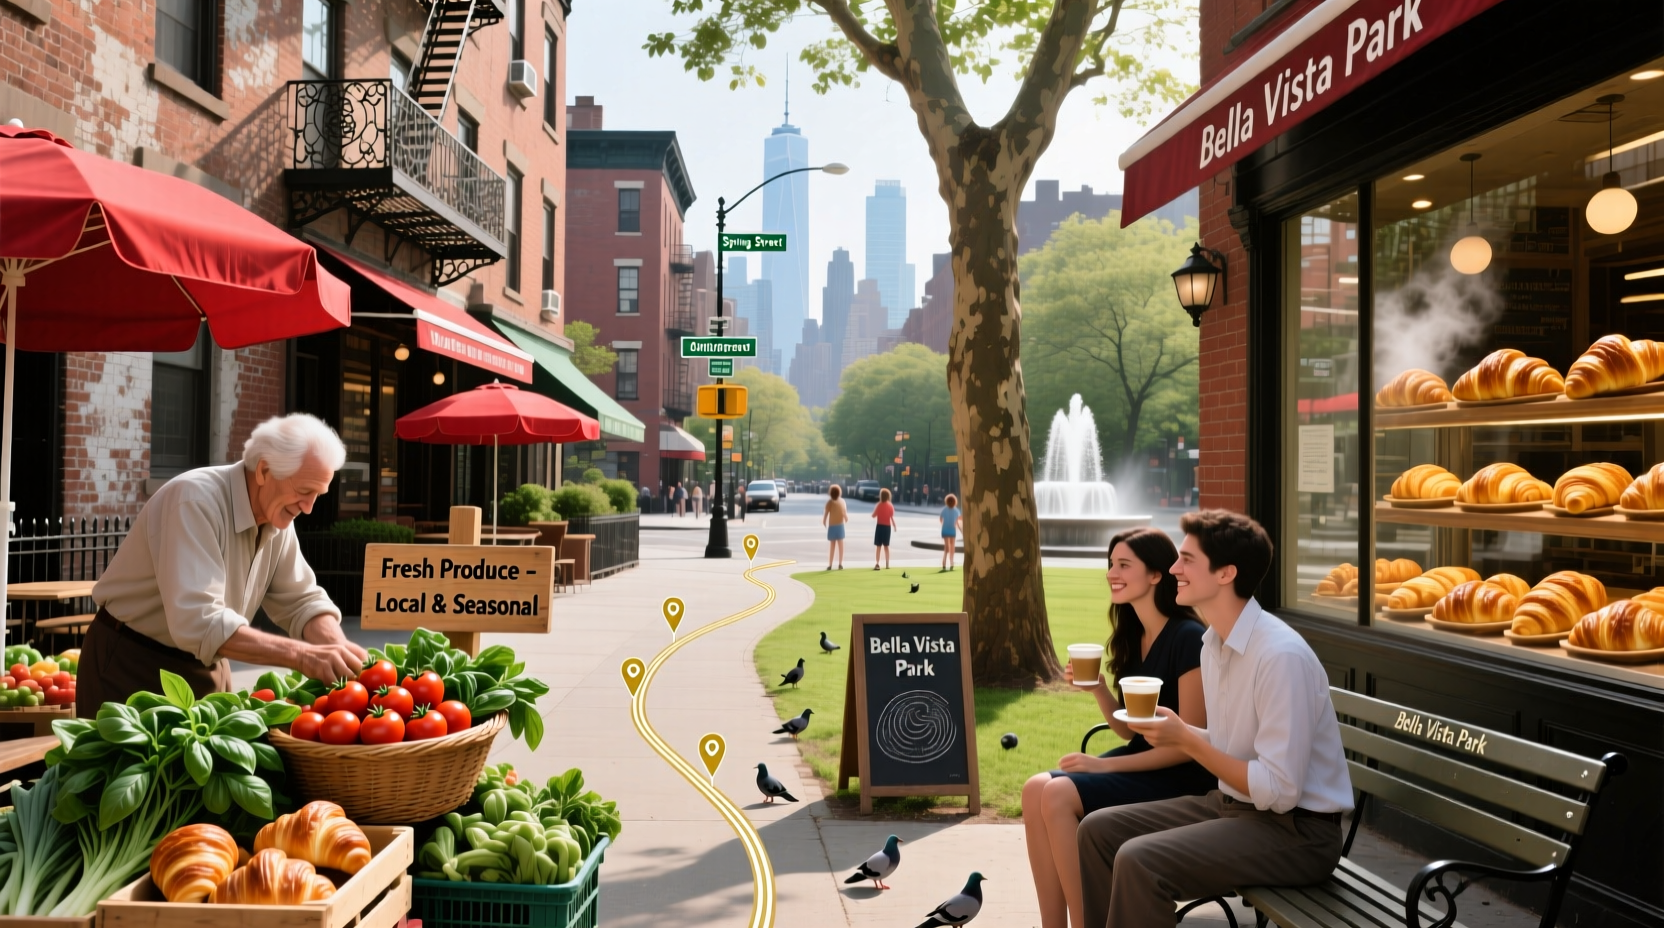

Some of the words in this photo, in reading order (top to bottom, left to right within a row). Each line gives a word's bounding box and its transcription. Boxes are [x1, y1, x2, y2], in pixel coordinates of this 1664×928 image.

[1200, 101, 1254, 169] Bella
[1264, 55, 1333, 126] Vista
[1345, 0, 1424, 77] Park
[381, 557, 434, 579] Fresh
[440, 558, 520, 580] Produce
[375, 592, 426, 613] Local
[431, 593, 446, 614] &
[452, 593, 538, 616] Seasonal
[870, 636, 911, 654] Bella
[913, 636, 955, 653] Vista
[895, 659, 935, 677] Park
[1394, 711, 1423, 736] Bella
[1426, 718, 1454, 745] Vista
[1456, 728, 1488, 755] Park
